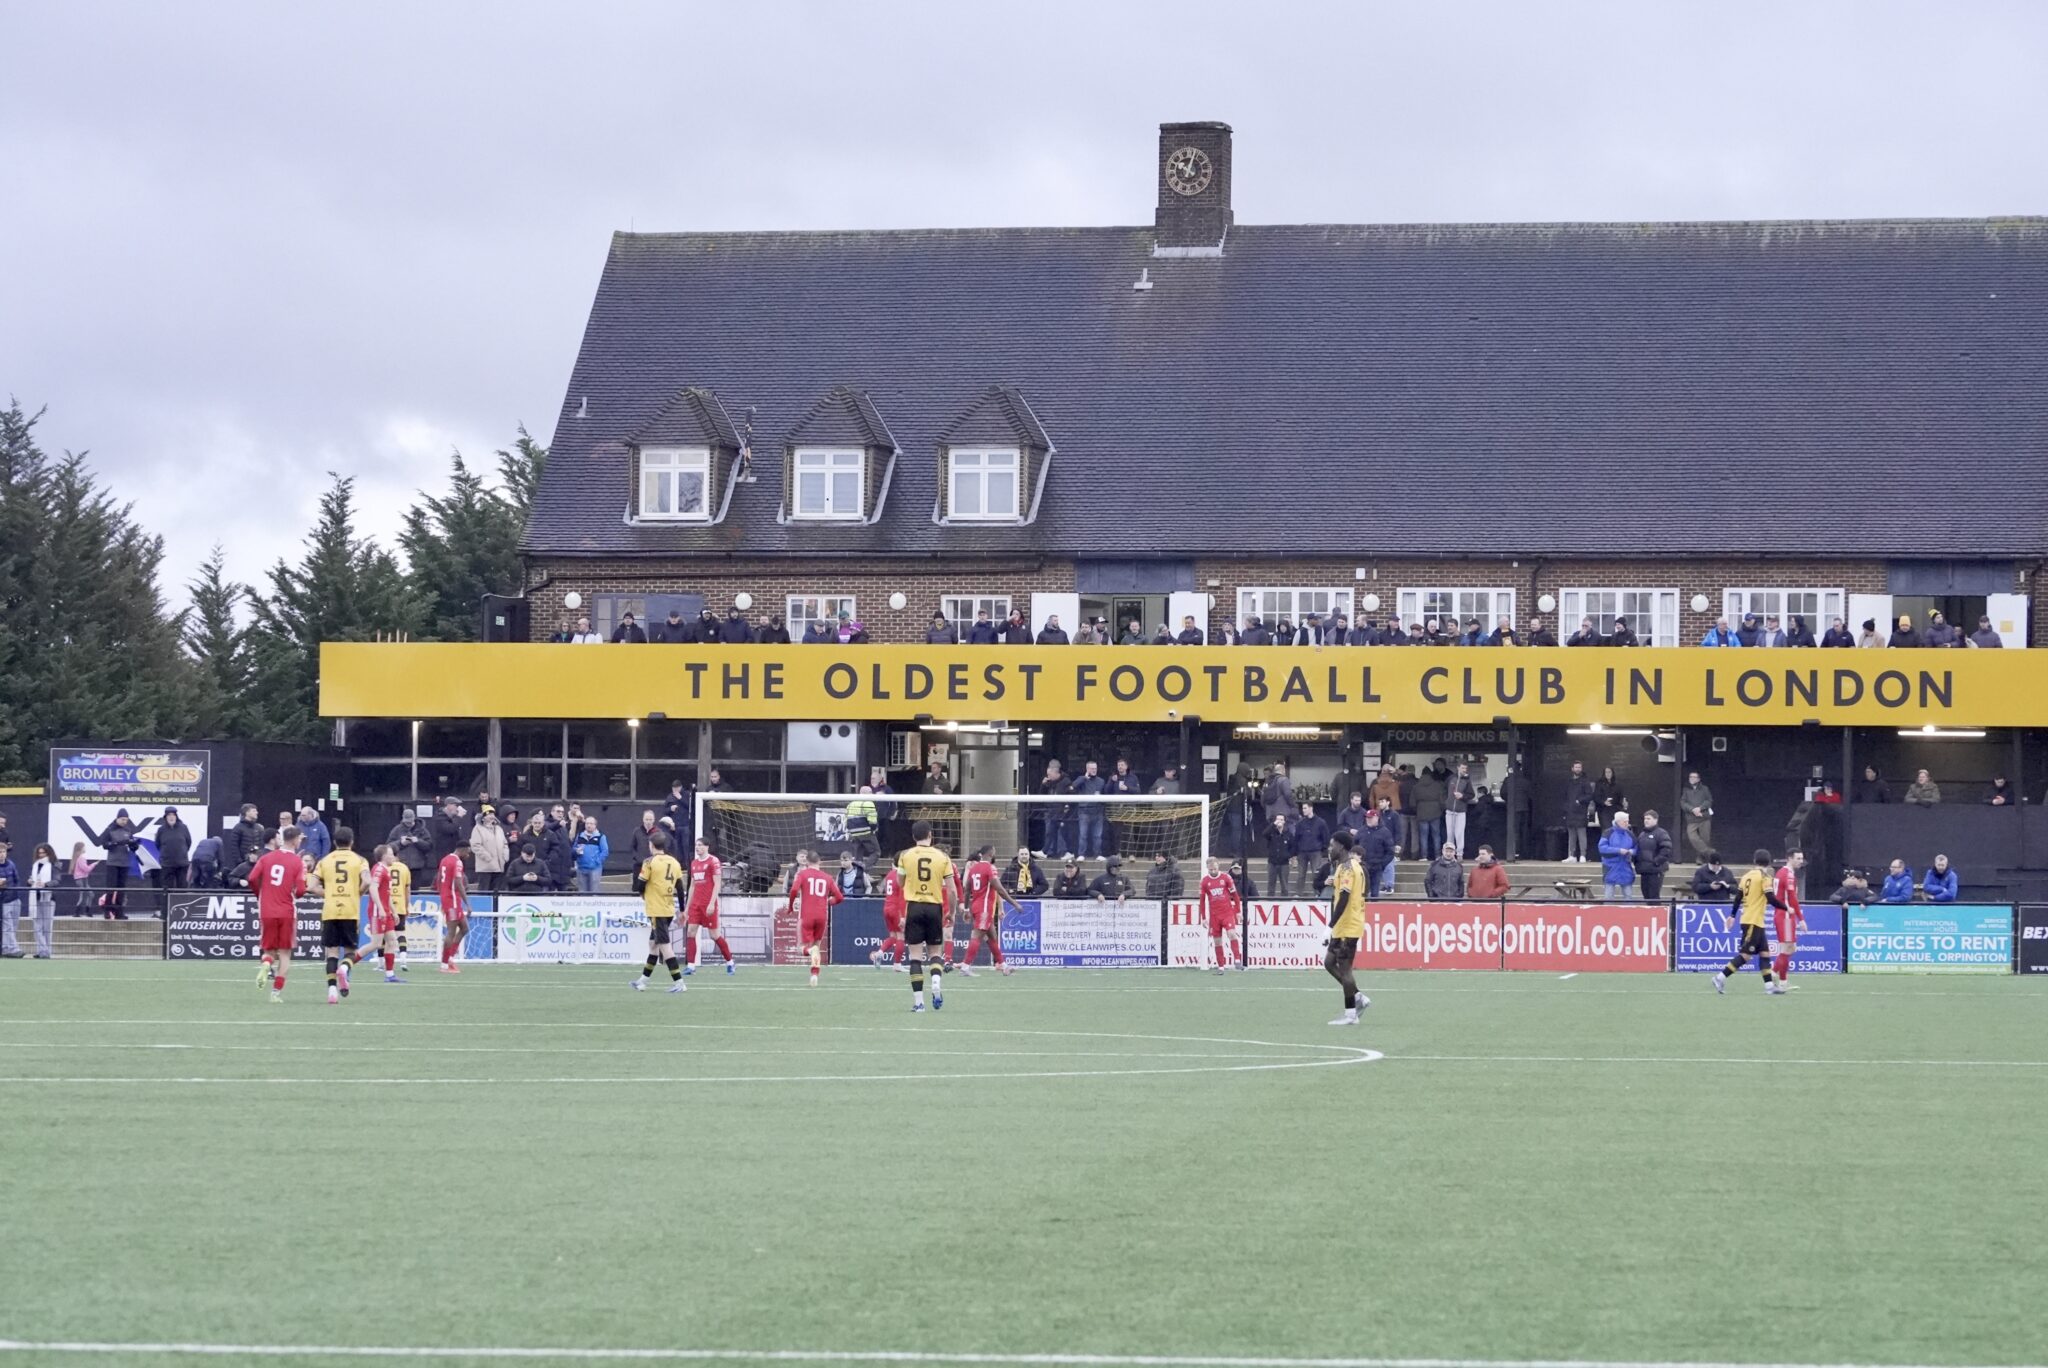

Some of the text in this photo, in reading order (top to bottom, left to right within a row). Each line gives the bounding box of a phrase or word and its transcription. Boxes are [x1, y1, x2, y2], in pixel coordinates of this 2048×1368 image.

[685, 663, 1953, 708] THE OLDEST FOOTBALL CLUB IN LONDON
[1387, 730, 1495, 741] FOOD & DRINKS
[63, 767, 197, 780] BROMLEY SIGNS
[270, 864, 285, 886] 9
[335, 861, 348, 883] 5
[665, 864, 674, 884] 4
[917, 857, 932, 881] 6
[807, 877, 827, 897] 10
[206, 896, 245, 919] ME
[170, 921, 245, 930] AUTOSERVICES
[1680, 908, 1743, 933] PAY
[854, 938, 869, 946] OJ
[1001, 931, 1037, 941] CLEAN
[1046, 931, 1151, 940] FREE DELIVERY RELIABLE SERVICE
[1003, 940, 1037, 950] WIPES
[1043, 943, 1157, 951] WWW.CLEANWIPES.CO.UK
[1680, 937, 1742, 953] HOME
[1852, 936, 2009, 950] OFFICES TO RENT
[1005, 957, 1025, 965] 0208
[1027, 957, 1043, 965] 859
[1044, 957, 1064, 965] 6231
[1852, 952, 2008, 963] CRAY AVENUE, ORPINGTON
[1798, 960, 1839, 971] 534052
